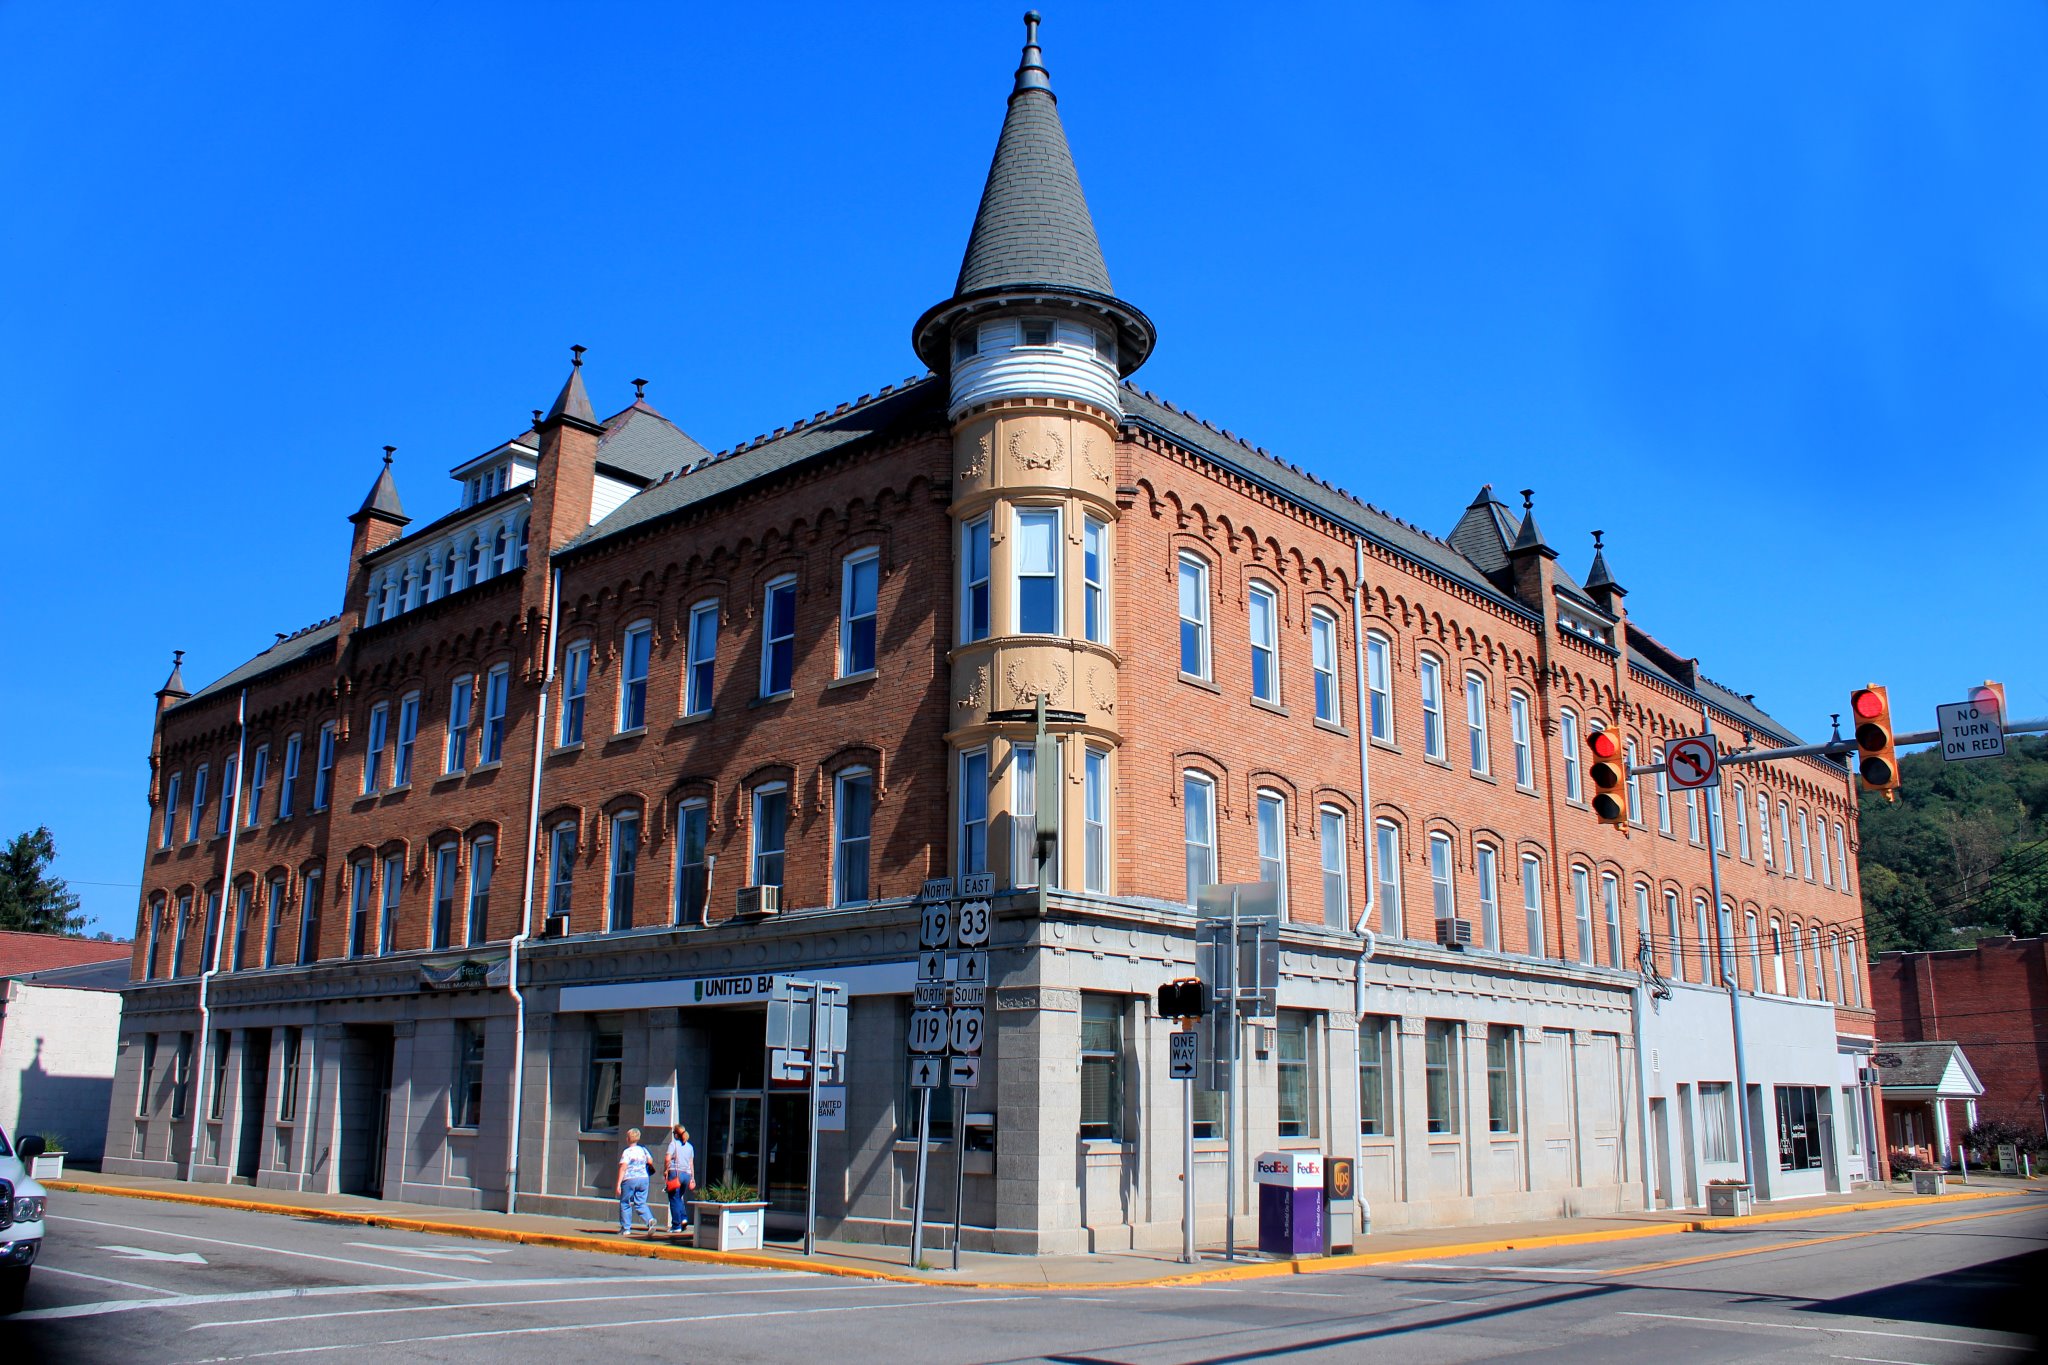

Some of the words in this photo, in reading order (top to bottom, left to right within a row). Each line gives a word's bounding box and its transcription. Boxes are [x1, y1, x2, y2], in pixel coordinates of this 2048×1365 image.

[1957, 708, 1979, 721] NO
[1952, 723, 1989, 737] TURN
[1947, 741, 1966, 754] ON
[1972, 738, 1999, 752] RED
[924, 883, 951, 899] NORTH
[964, 877, 989, 894] EAST
[925, 913, 946, 939] 19
[962, 909, 987, 936] 33
[705, 977, 753, 997] UNITED
[916, 986, 945, 1002] NORTH
[954, 986, 984, 1002] SOUTH
[917, 1018, 940, 1044] 119
[956, 1018, 979, 1045] 19
[1173, 1036, 1195, 1048] ONE
[1172, 1049, 1195, 1060] WAY
[651, 1099, 671, 1107] UNITED
[818, 1100, 842, 1108] UNITED
[818, 1108, 836, 1116] BANK
[1258, 1161, 1289, 1173] FedEx
[1297, 1162, 1320, 1174] FedEx
